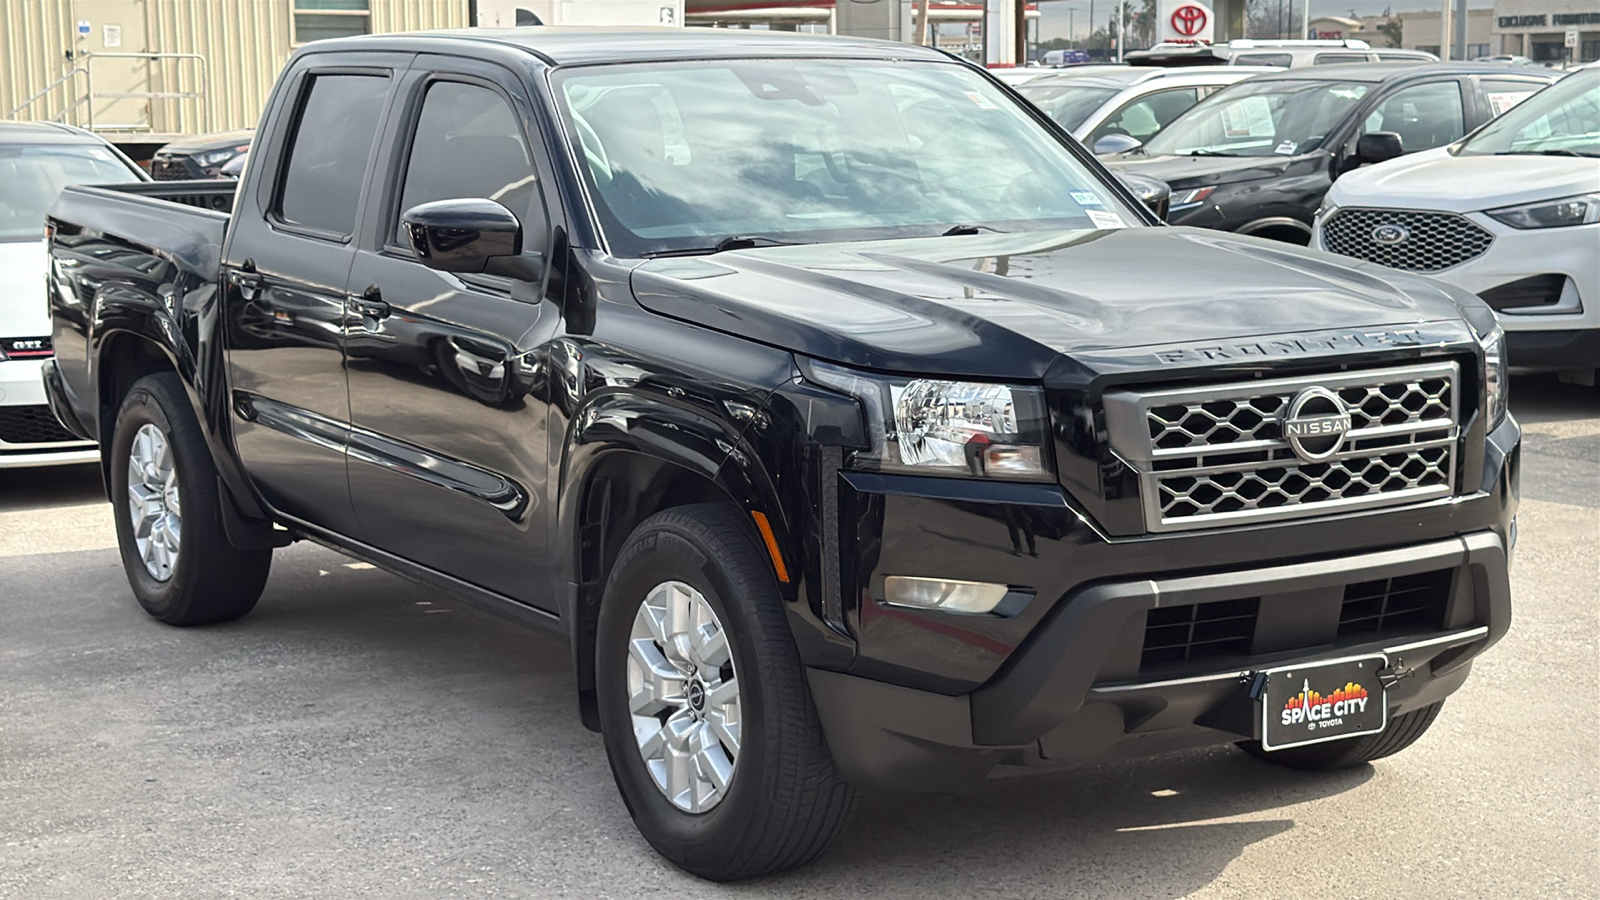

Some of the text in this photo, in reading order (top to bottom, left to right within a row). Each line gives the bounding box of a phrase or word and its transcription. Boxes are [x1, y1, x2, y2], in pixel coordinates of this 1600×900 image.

[1498, 15, 1546, 28] EXCLUSIVE
[13, 341, 42, 349] GTI
[1155, 329, 1425, 364] FRONTIER
[1288, 414, 1352, 436] NISSAN
[1282, 693, 1368, 724] SPACE CITY
[1318, 717, 1343, 729] TOYOTA
